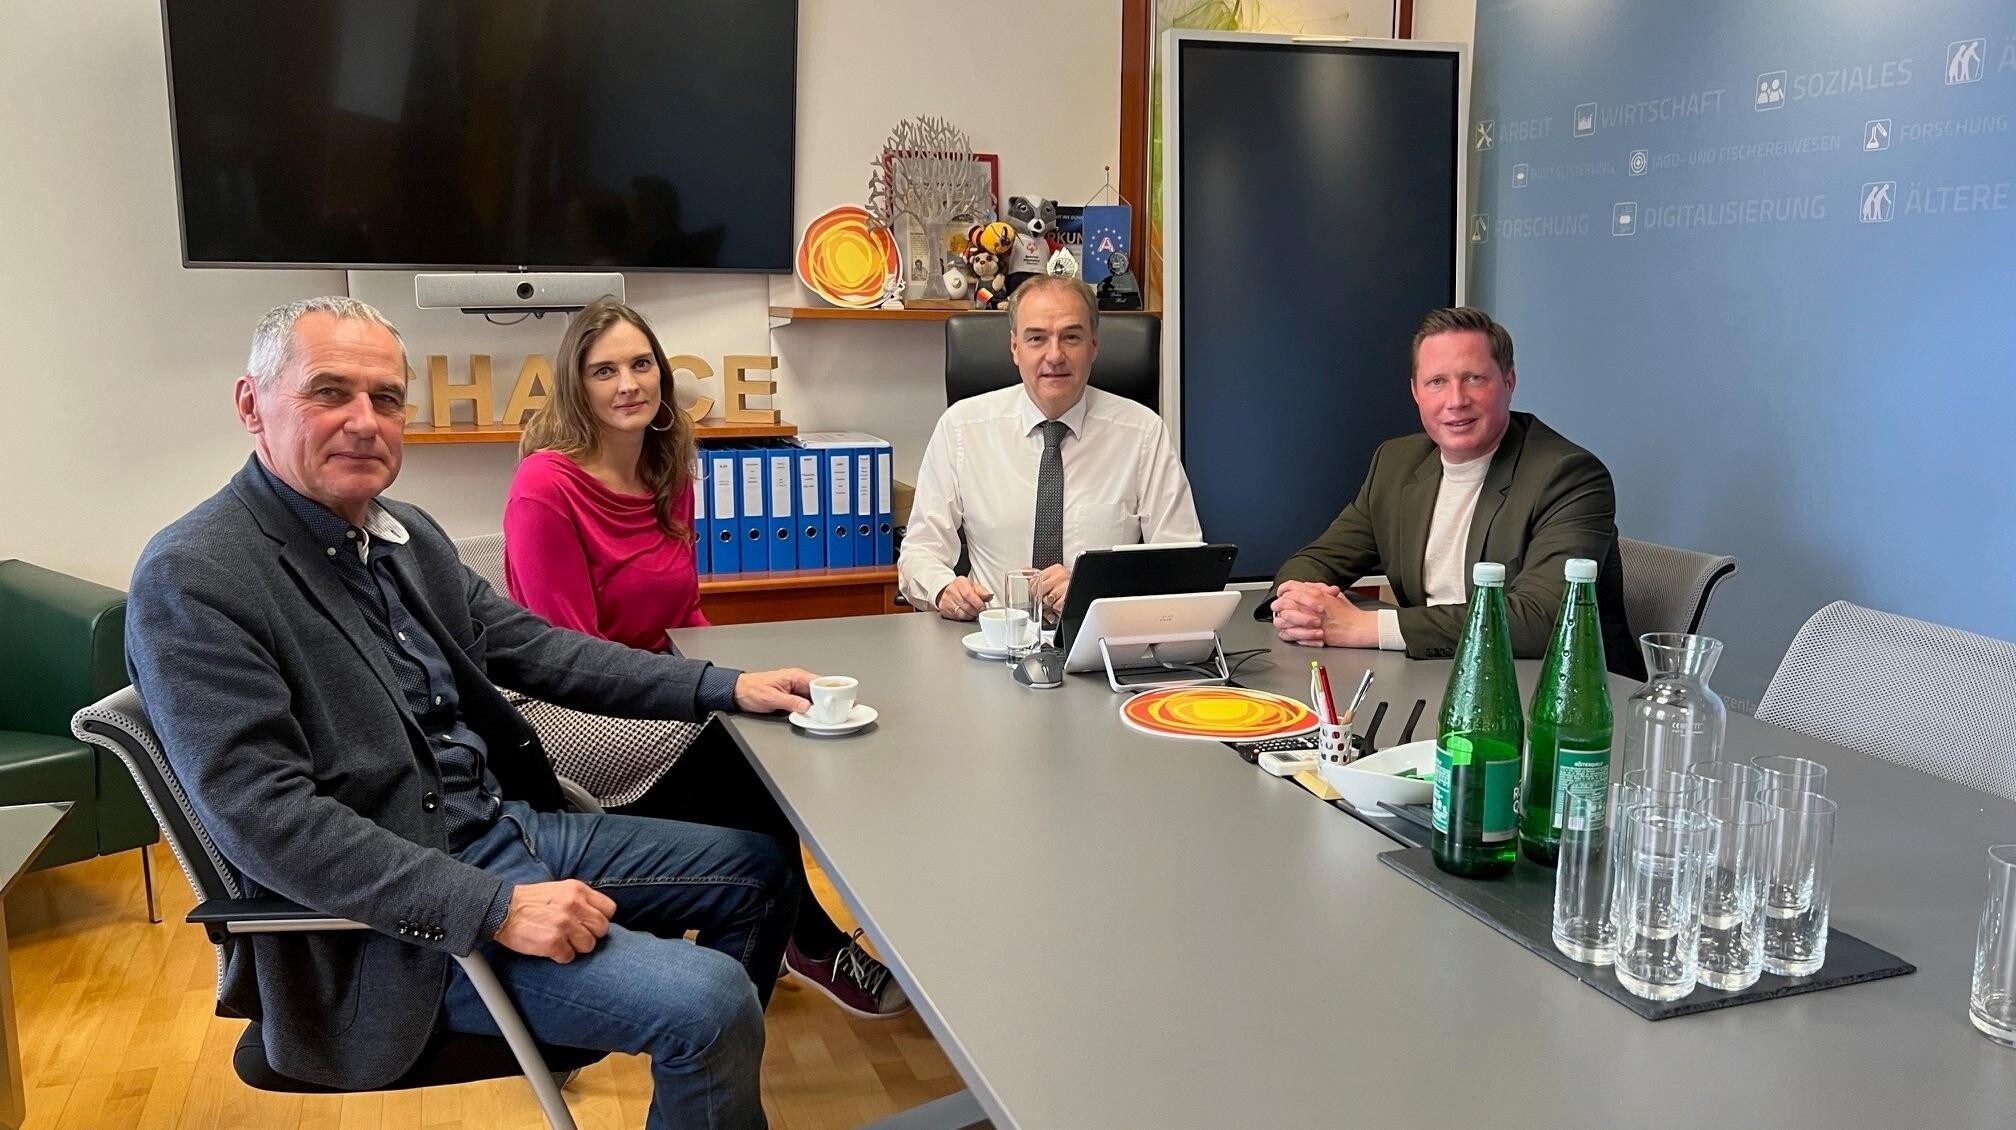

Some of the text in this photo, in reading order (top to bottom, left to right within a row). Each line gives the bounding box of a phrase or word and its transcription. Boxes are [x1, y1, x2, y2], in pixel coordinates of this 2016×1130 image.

[1792, 58, 1914, 101] SOZIALES
[1600, 88, 1726, 129] WIRTSCHAFT
[1499, 117, 1553, 145] ARBEIT
[1900, 113, 2008, 142] FORSCHUNG
[1719, 134, 1841, 163] FISCHEREIWESEN
[1644, 194, 1826, 231] DIGITALISIERUNG
[1904, 181, 2010, 217] ÄLTERE
[1495, 213, 1589, 239] FORSCHUNG
